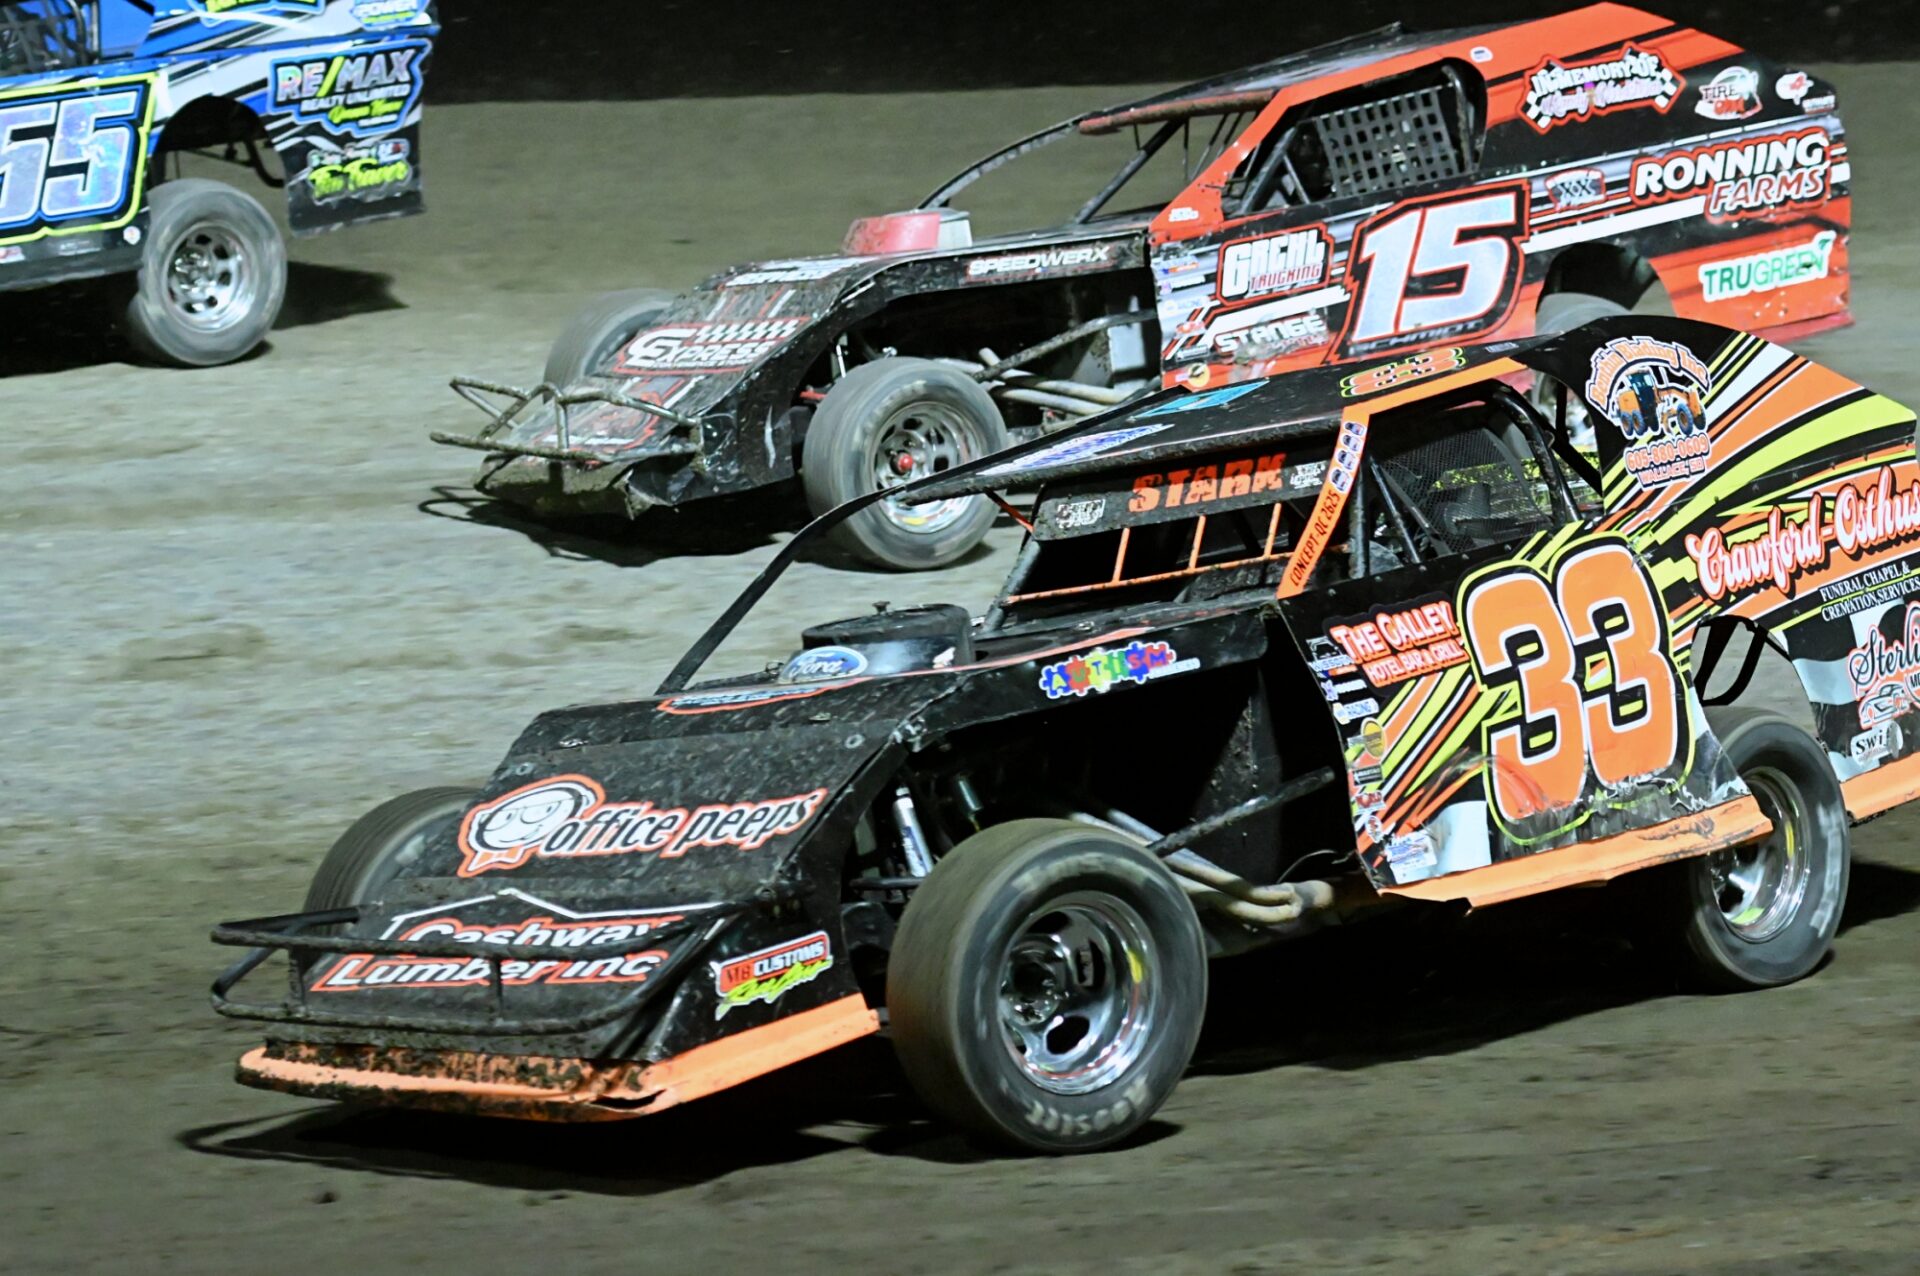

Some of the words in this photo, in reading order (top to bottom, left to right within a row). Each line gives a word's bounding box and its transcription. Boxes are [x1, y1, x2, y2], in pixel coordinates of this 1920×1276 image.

[276, 49, 416, 102] RE/MAX
[1634, 132, 1829, 197] RONNING
[1709, 168, 1824, 215] FARMS
[969, 246, 1110, 276] SPEEDWERX
[1352, 192, 1516, 343] 15
[1703, 248, 1826, 296] TRUGREEN
[1215, 314, 1327, 353] STANGE
[1128, 452, 1287, 514] STARK
[1820, 576, 1864, 602] FUNERAL
[1863, 563, 1901, 587] CHAPEL
[1901, 560, 1911, 575] &
[1822, 591, 1877, 622] CREMATION
[1876, 576, 1920, 603] SERVICES
[789, 652, 846, 678] Ford
[1331, 626, 1387, 661] THE
[1466, 544, 1679, 821] 33
[543, 806, 678, 853] office
[668, 793, 822, 854] peeps
